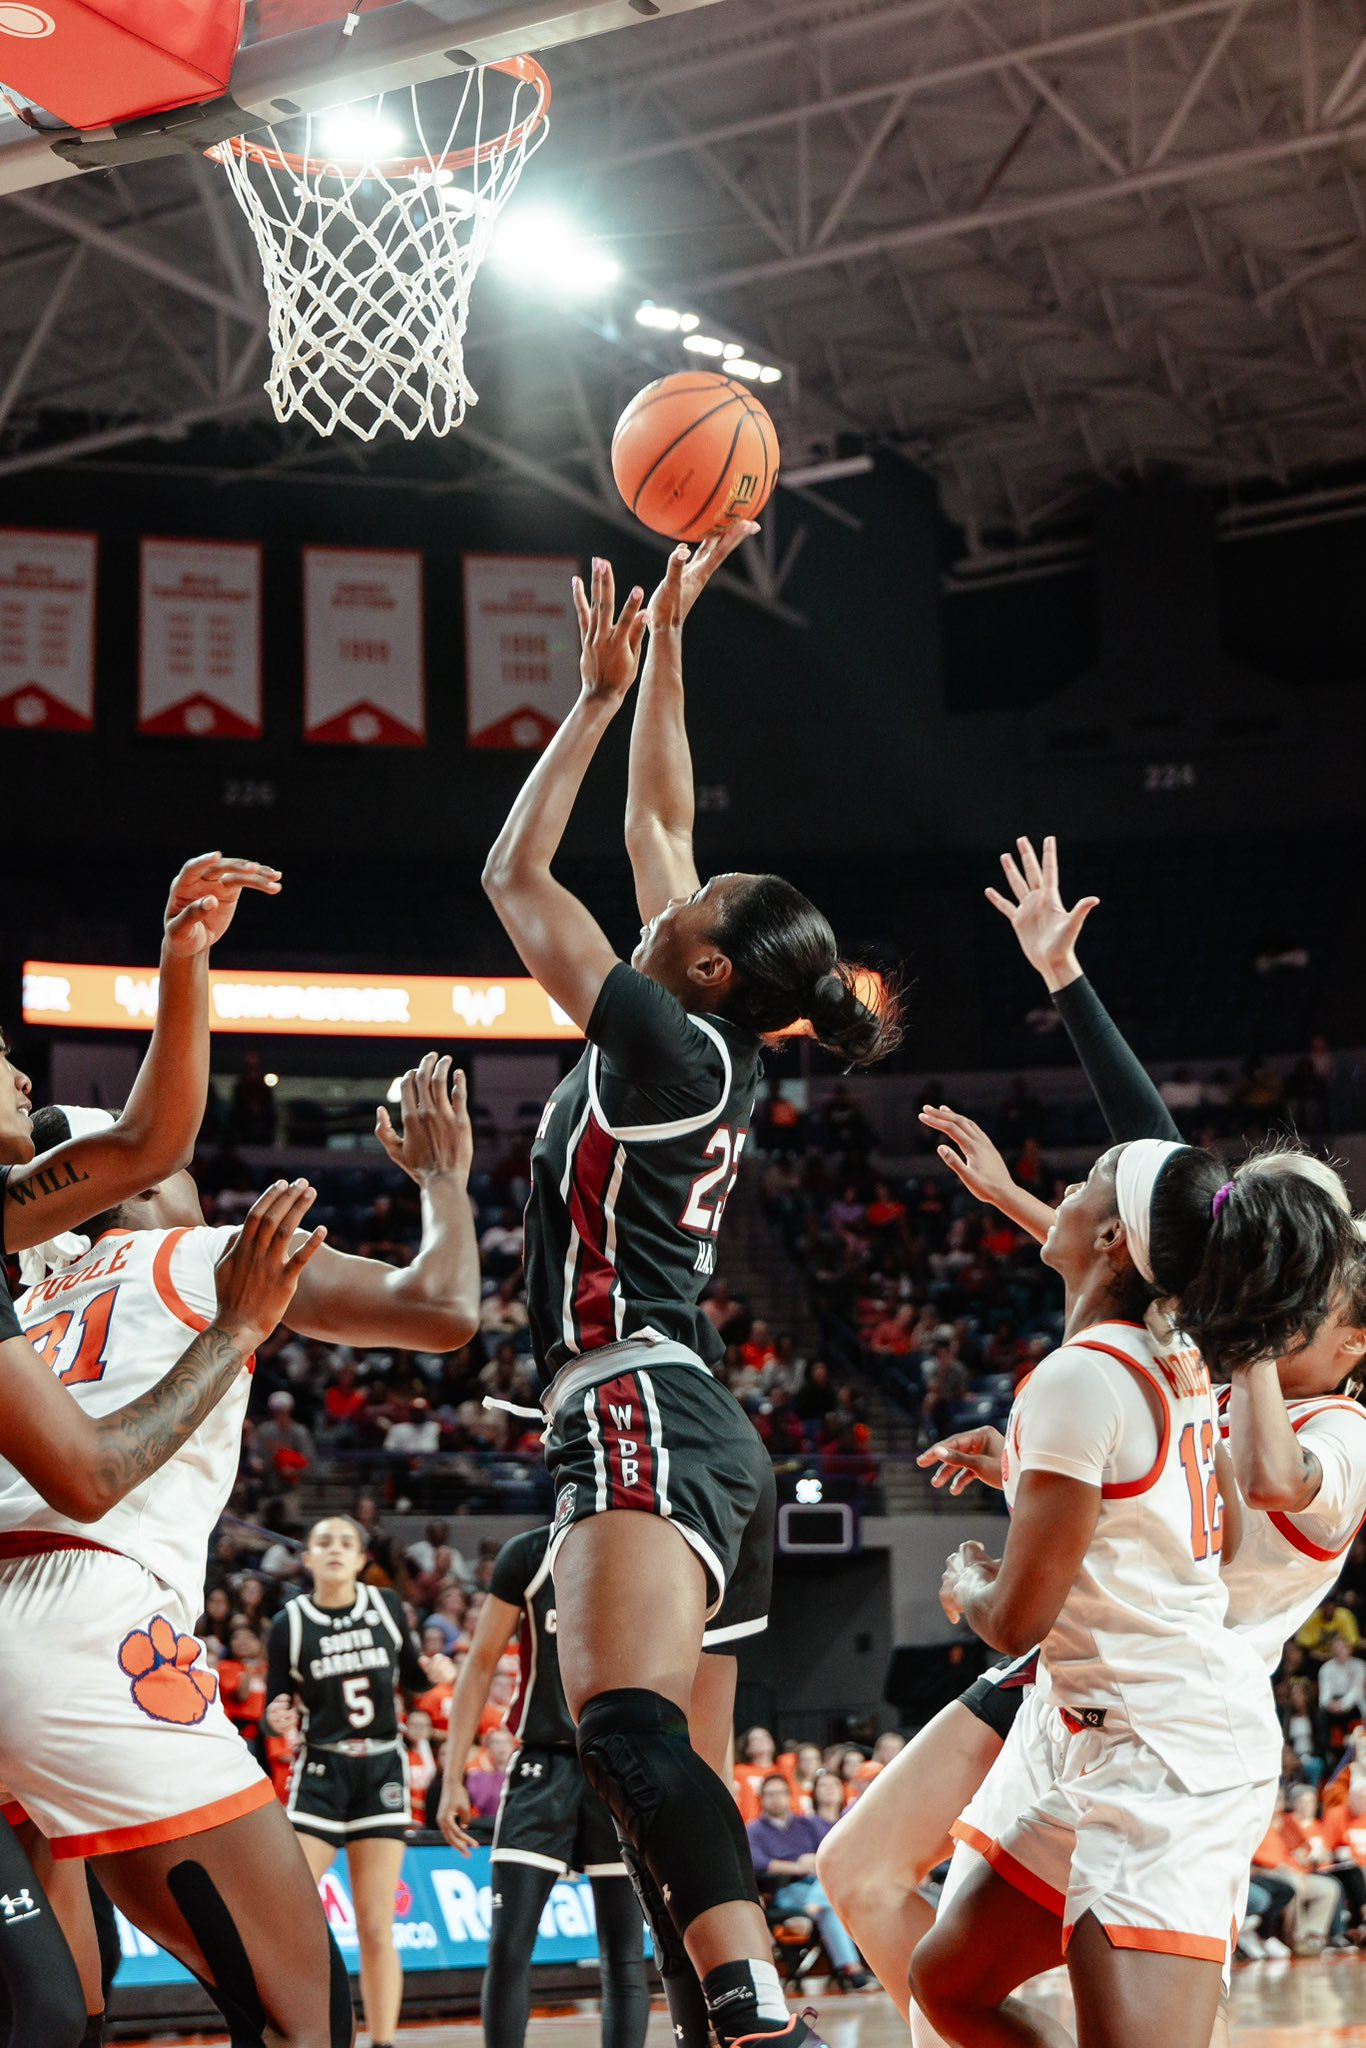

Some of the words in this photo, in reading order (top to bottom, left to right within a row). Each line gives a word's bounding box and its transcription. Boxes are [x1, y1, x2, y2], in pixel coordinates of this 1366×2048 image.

[696, 784, 731, 812] 25
[7, 1159, 90, 1206] WILL
[23, 1240, 135, 1315] POOLE
[1179, 1419, 1225, 1562] 12
[342, 1676, 375, 1729] 5
[1086, 1711, 1099, 1725] 42
